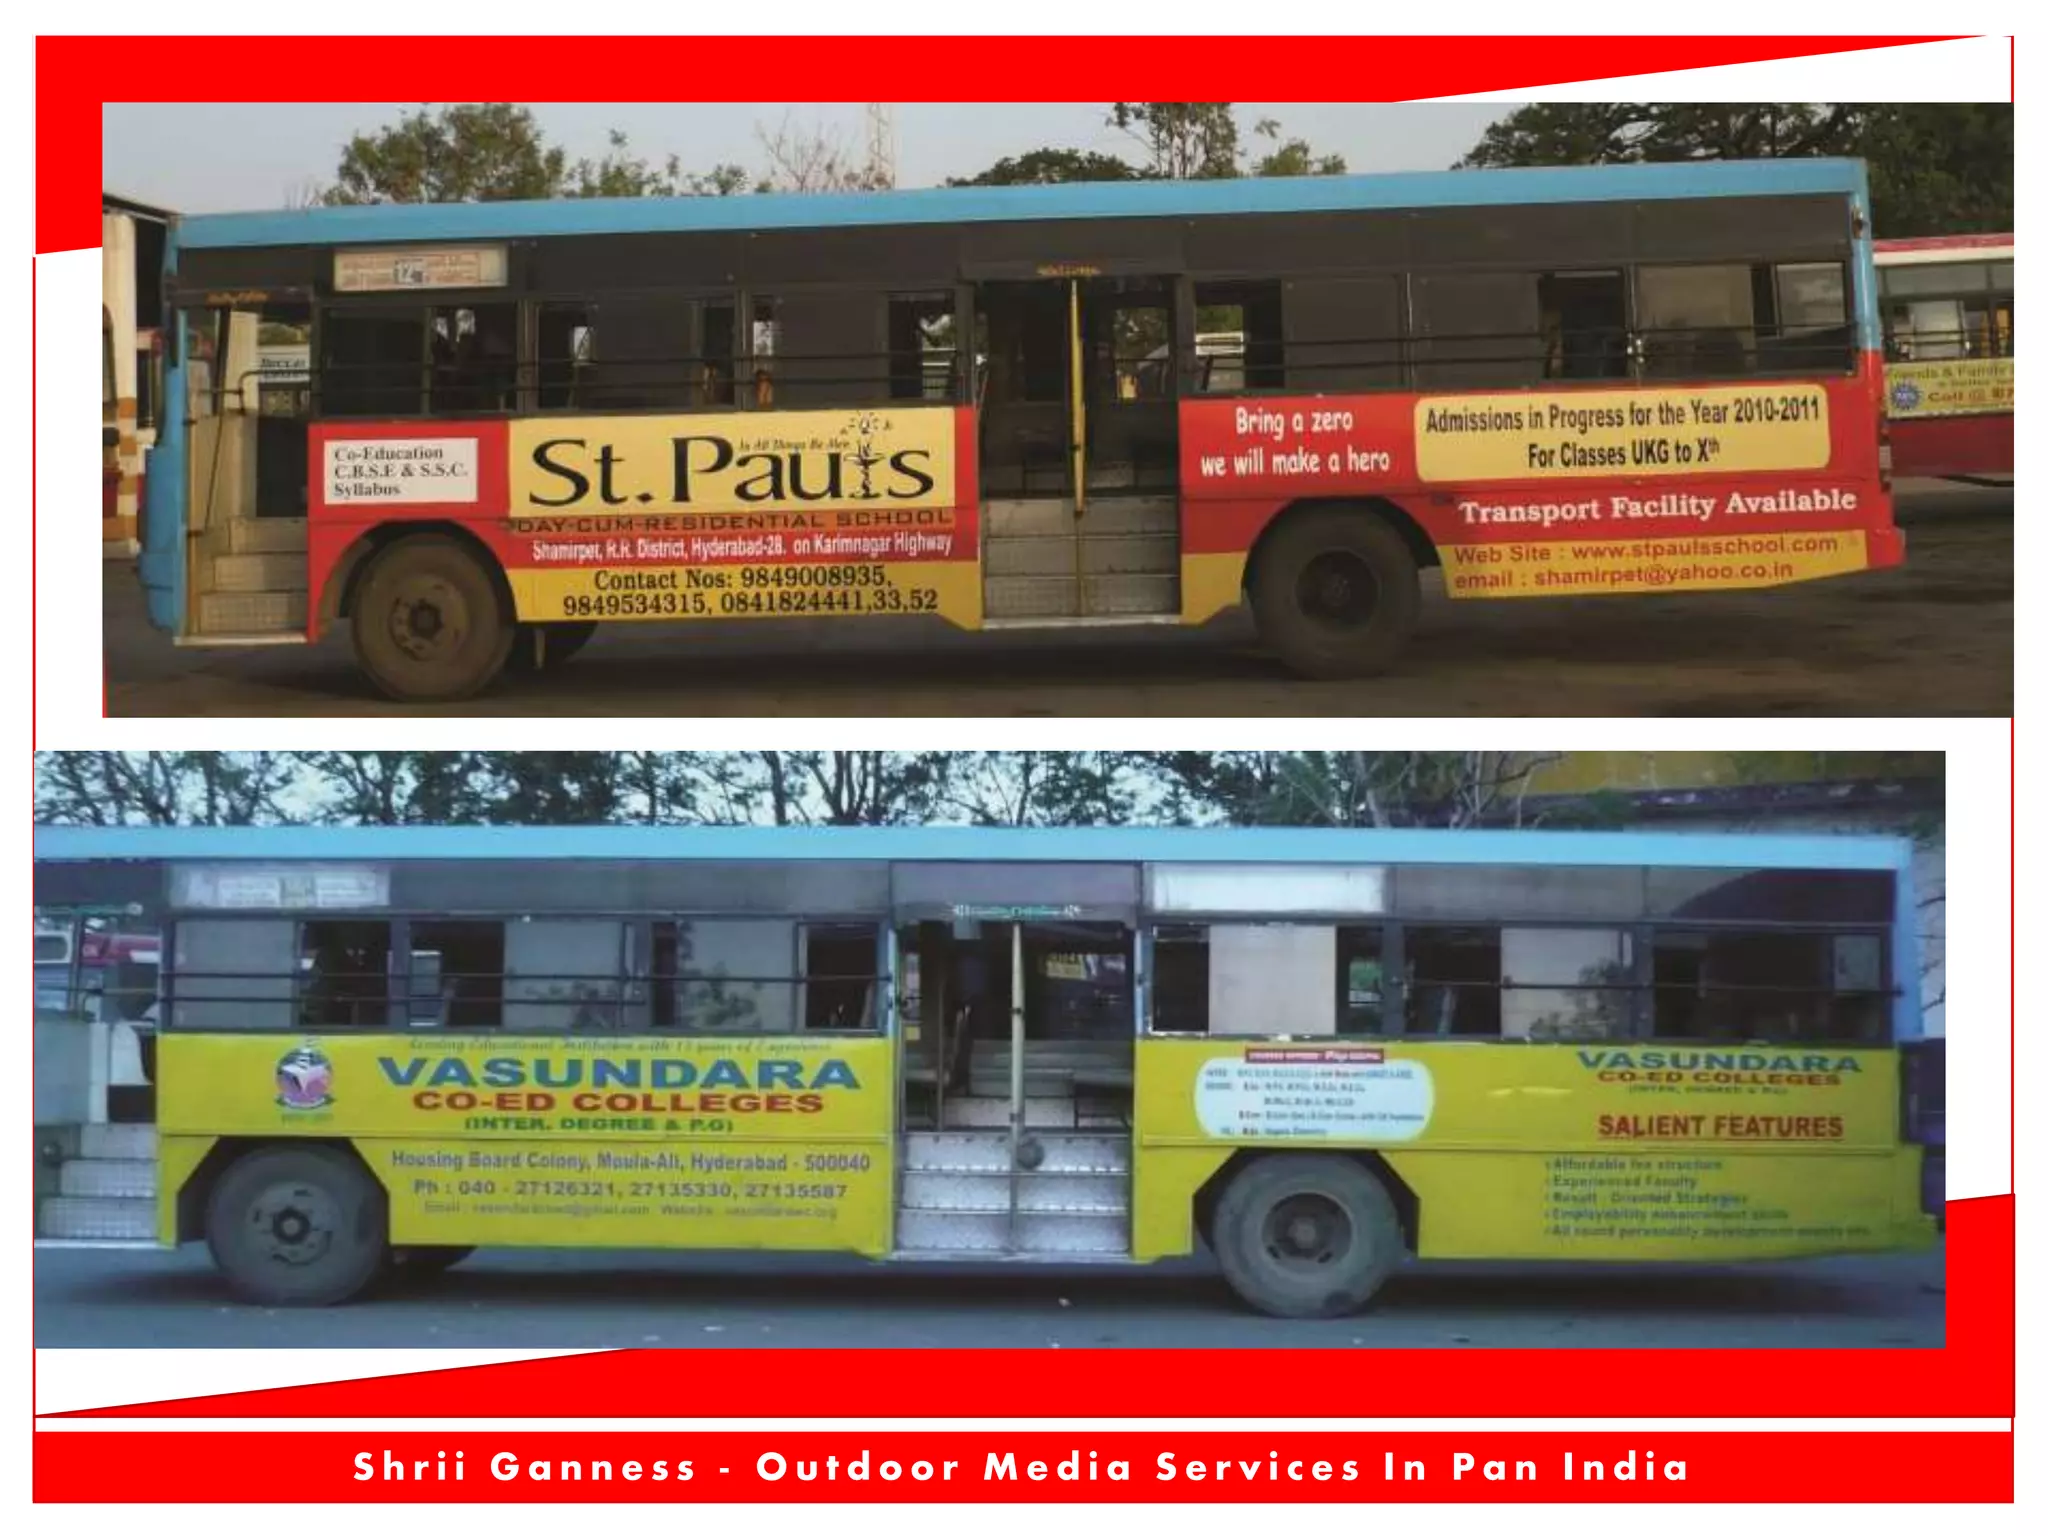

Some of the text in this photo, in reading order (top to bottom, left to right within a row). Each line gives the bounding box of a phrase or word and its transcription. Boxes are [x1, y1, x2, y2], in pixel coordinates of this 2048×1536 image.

[1236, 406, 1353, 441] Bring a zero
[1425, 395, 1820, 434] Admissions in Progress for the Year 2010-2011
[334, 445, 444, 461] Co-Education
[1201, 445, 1391, 476] we will make a hero
[1529, 443, 1557, 469] For
[1560, 441, 1626, 468] Classes
[1632, 440, 1669, 465] UKG
[1675, 441, 1693, 462] to
[401, 462, 414, 478] &
[419, 460, 468, 478] S.S.C.
[529, 438, 654, 507] St.
[334, 481, 400, 499] Syllabus
[1458, 488, 1857, 528] Transport Facility Available
[518, 509, 954, 534] DAY-CUM-RESIDENTIAL SCHOOL
[637, 538, 689, 560] District,
[794, 538, 811, 555] on
[814, 534, 891, 557] Karimnagar
[893, 531, 953, 556] Highway
[1454, 546, 1503, 564] Web
[1510, 543, 1551, 563] Site
[1572, 535, 1838, 565] www.stpaulsschool.com
[594, 566, 893, 591] Contact Nos: 9849008935,
[1454, 570, 1514, 590] email
[1533, 561, 1794, 588] shamirpet@yahoo.co.in
[563, 595, 713, 617] 9849534315,
[378, 1057, 860, 1089] VASUNDARA
[1577, 1052, 1863, 1073] VASUNDARA
[1598, 1071, 1842, 1086] CO-ED COLLEGES
[413, 1091, 824, 1113] CO-ED COLLEGES
[561, 1117, 656, 1131] DEGREE
[665, 1118, 682, 1131] &
[1599, 1115, 1844, 1138] SALIENT FEATURES
[392, 1150, 463, 1173] Housing
[468, 1151, 522, 1169] Board
[526, 1152, 591, 1173] Colony,
[597, 1152, 685, 1173] Moula-Ali,
[691, 1153, 787, 1175] Hyderabad
[1553, 1157, 1626, 1170] Affordable
[413, 1180, 438, 1195] Ph
[458, 1181, 496, 1196] 040
[515, 1181, 623, 1199] 27126321,
